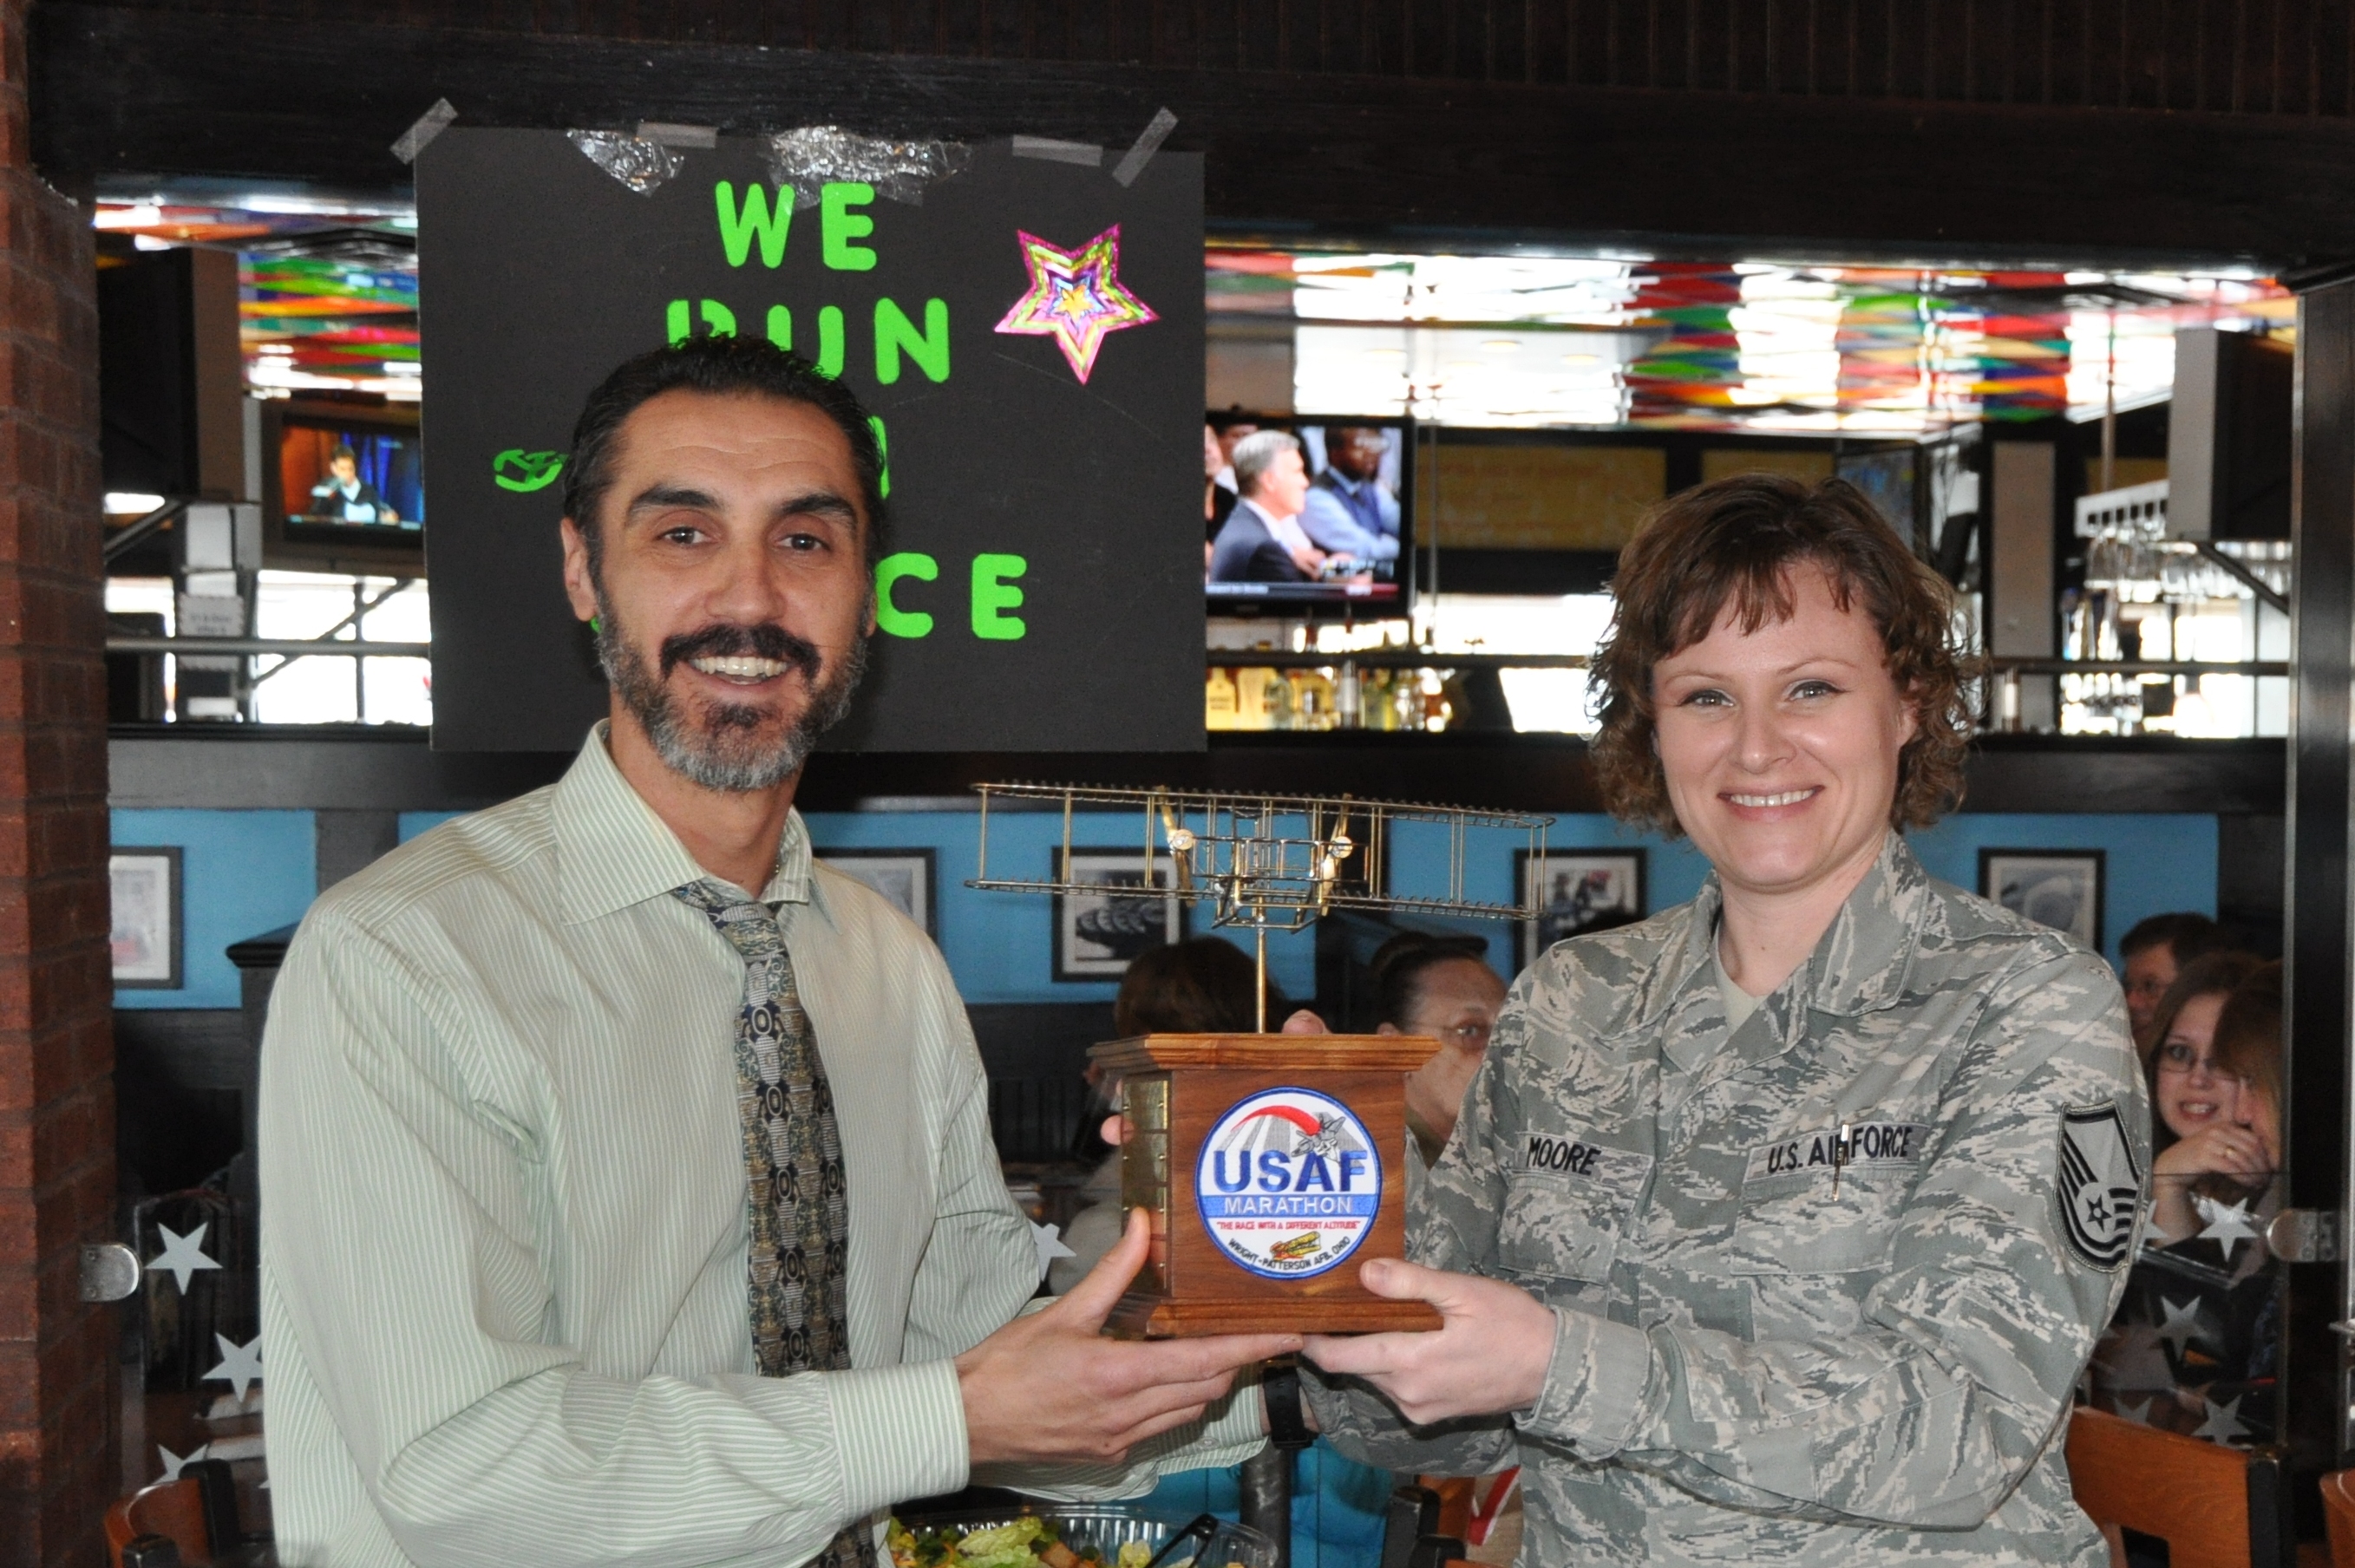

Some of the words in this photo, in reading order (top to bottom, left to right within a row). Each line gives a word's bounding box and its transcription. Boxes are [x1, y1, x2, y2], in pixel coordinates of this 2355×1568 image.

[716, 180, 877, 271] WE
[1526, 1137, 1602, 1176] MOORE
[1767, 1142, 1803, 1173] U.S.
[1851, 1126, 1913, 1159] FORCE
[1213, 1150, 1368, 1192] USAF
[1225, 1197, 1351, 1214] MARATHON
[1235, 1221, 1255, 1230] RACE
[1277, 1221, 1284, 1230] A
[1285, 1221, 1322, 1230] DIFFERENT
[1331, 1236, 1351, 1255] OHIO
